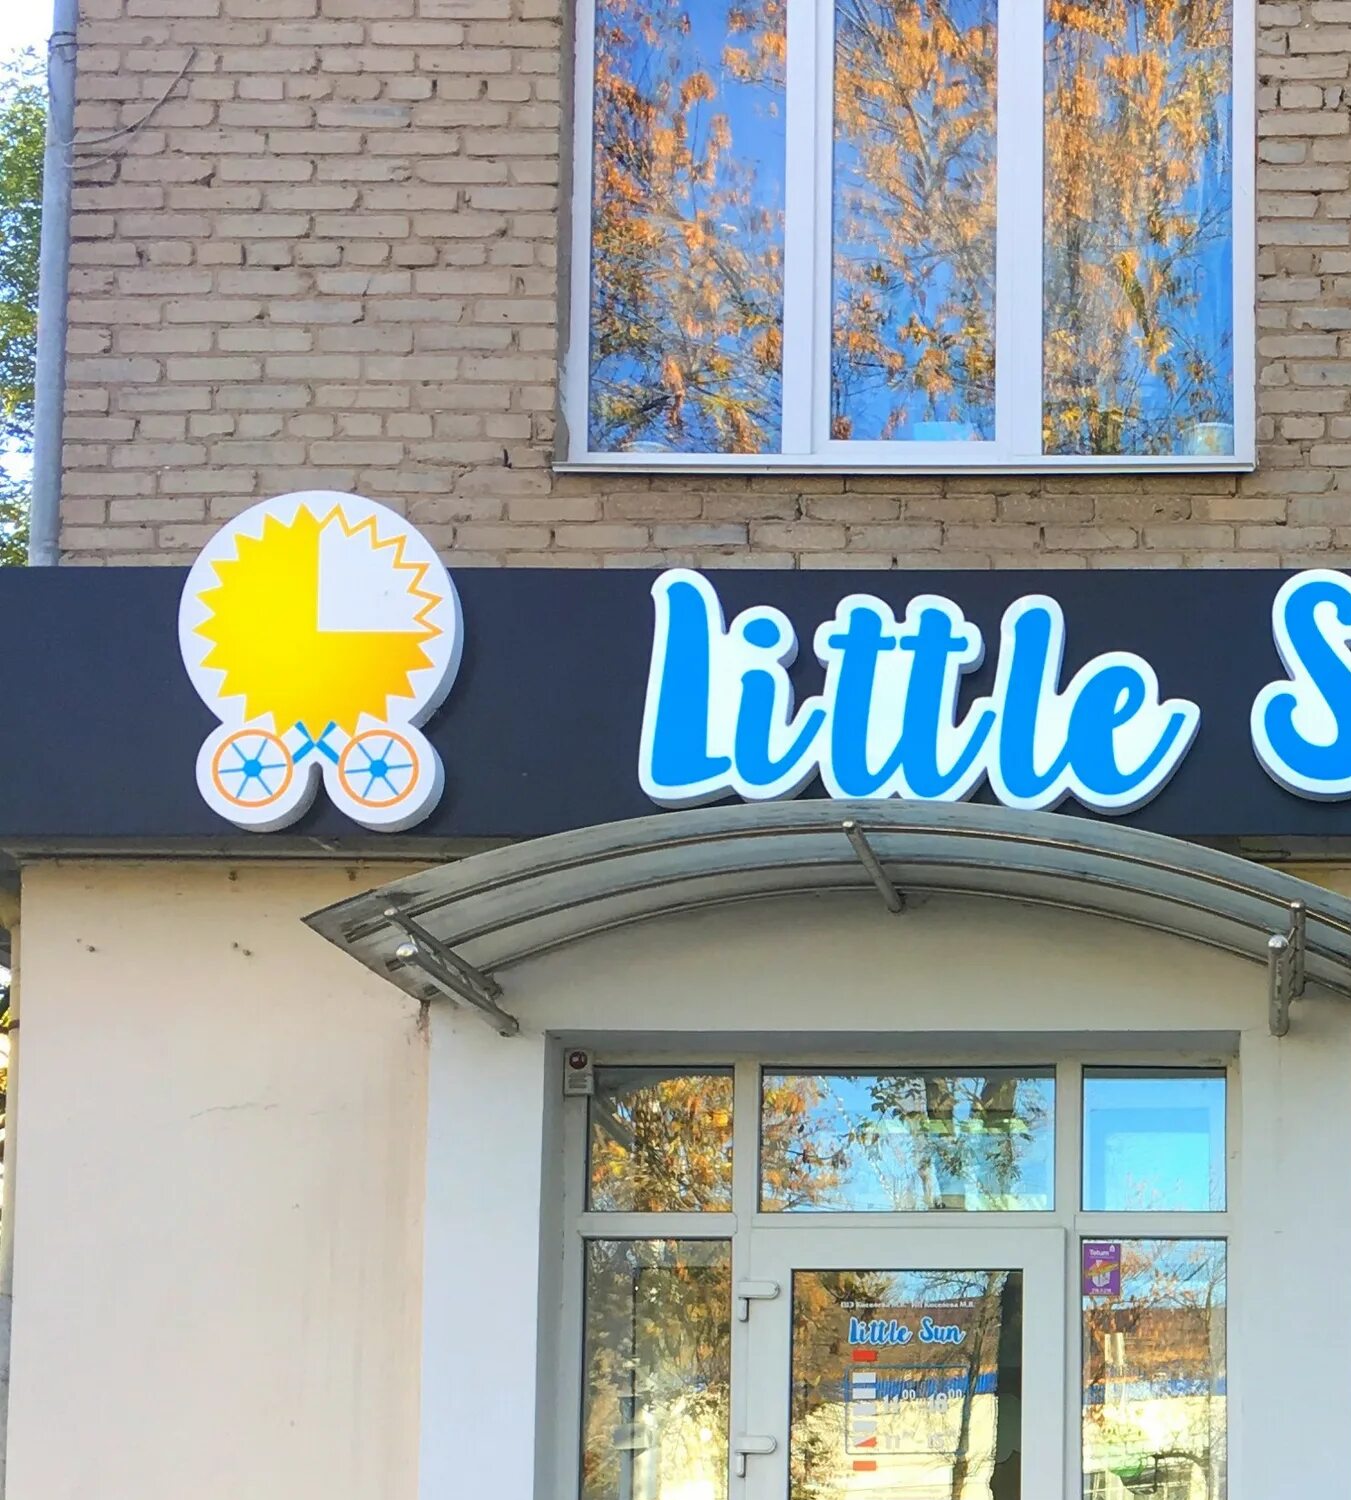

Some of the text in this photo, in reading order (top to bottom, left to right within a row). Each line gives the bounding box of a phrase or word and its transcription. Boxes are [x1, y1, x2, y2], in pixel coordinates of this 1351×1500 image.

[646, 575, 1193, 806] Little
[848, 1316, 966, 1345] Little Sun
